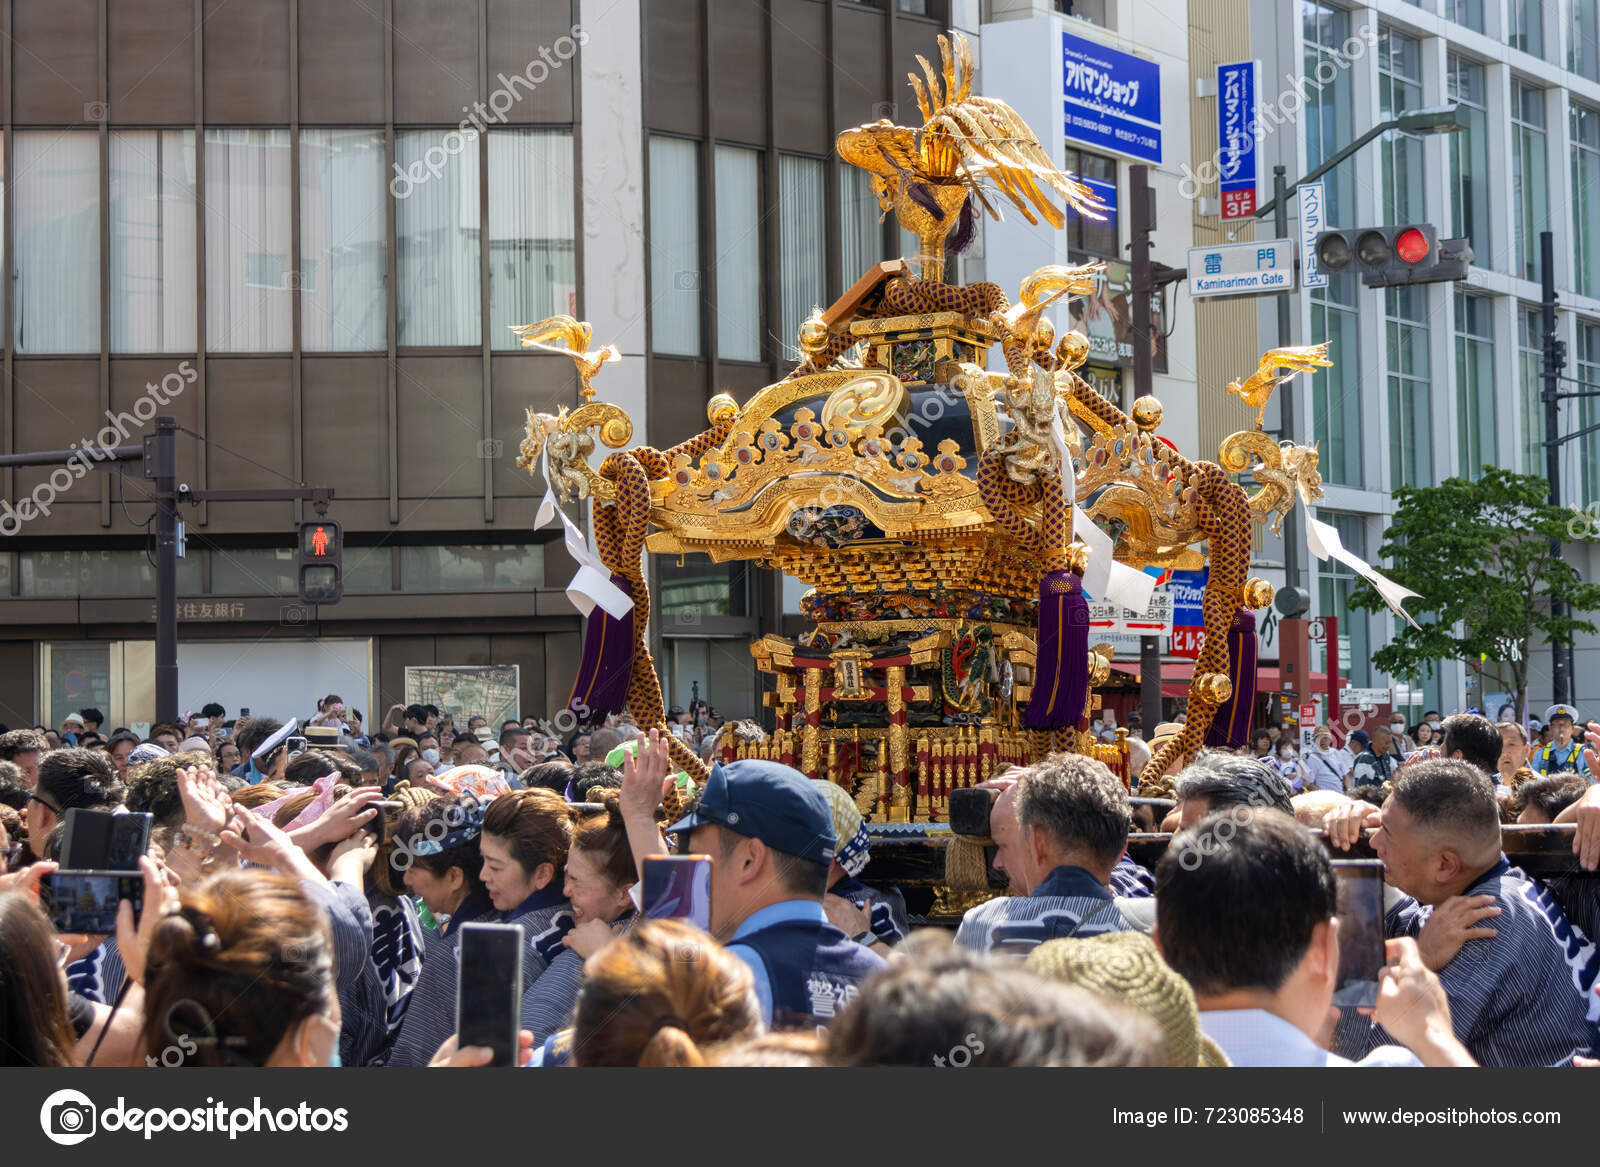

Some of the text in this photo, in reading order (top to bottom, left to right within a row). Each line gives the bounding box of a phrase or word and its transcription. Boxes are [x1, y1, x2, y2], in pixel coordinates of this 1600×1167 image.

[1065, 60, 1139, 107] アパマンショップ
[1224, 70, 1241, 179] アパマンショップ
[1226, 200, 1251, 216] 3F
[1204, 247, 1276, 275] 雷門
[1197, 273, 1284, 291] Kaminarimon Gate
